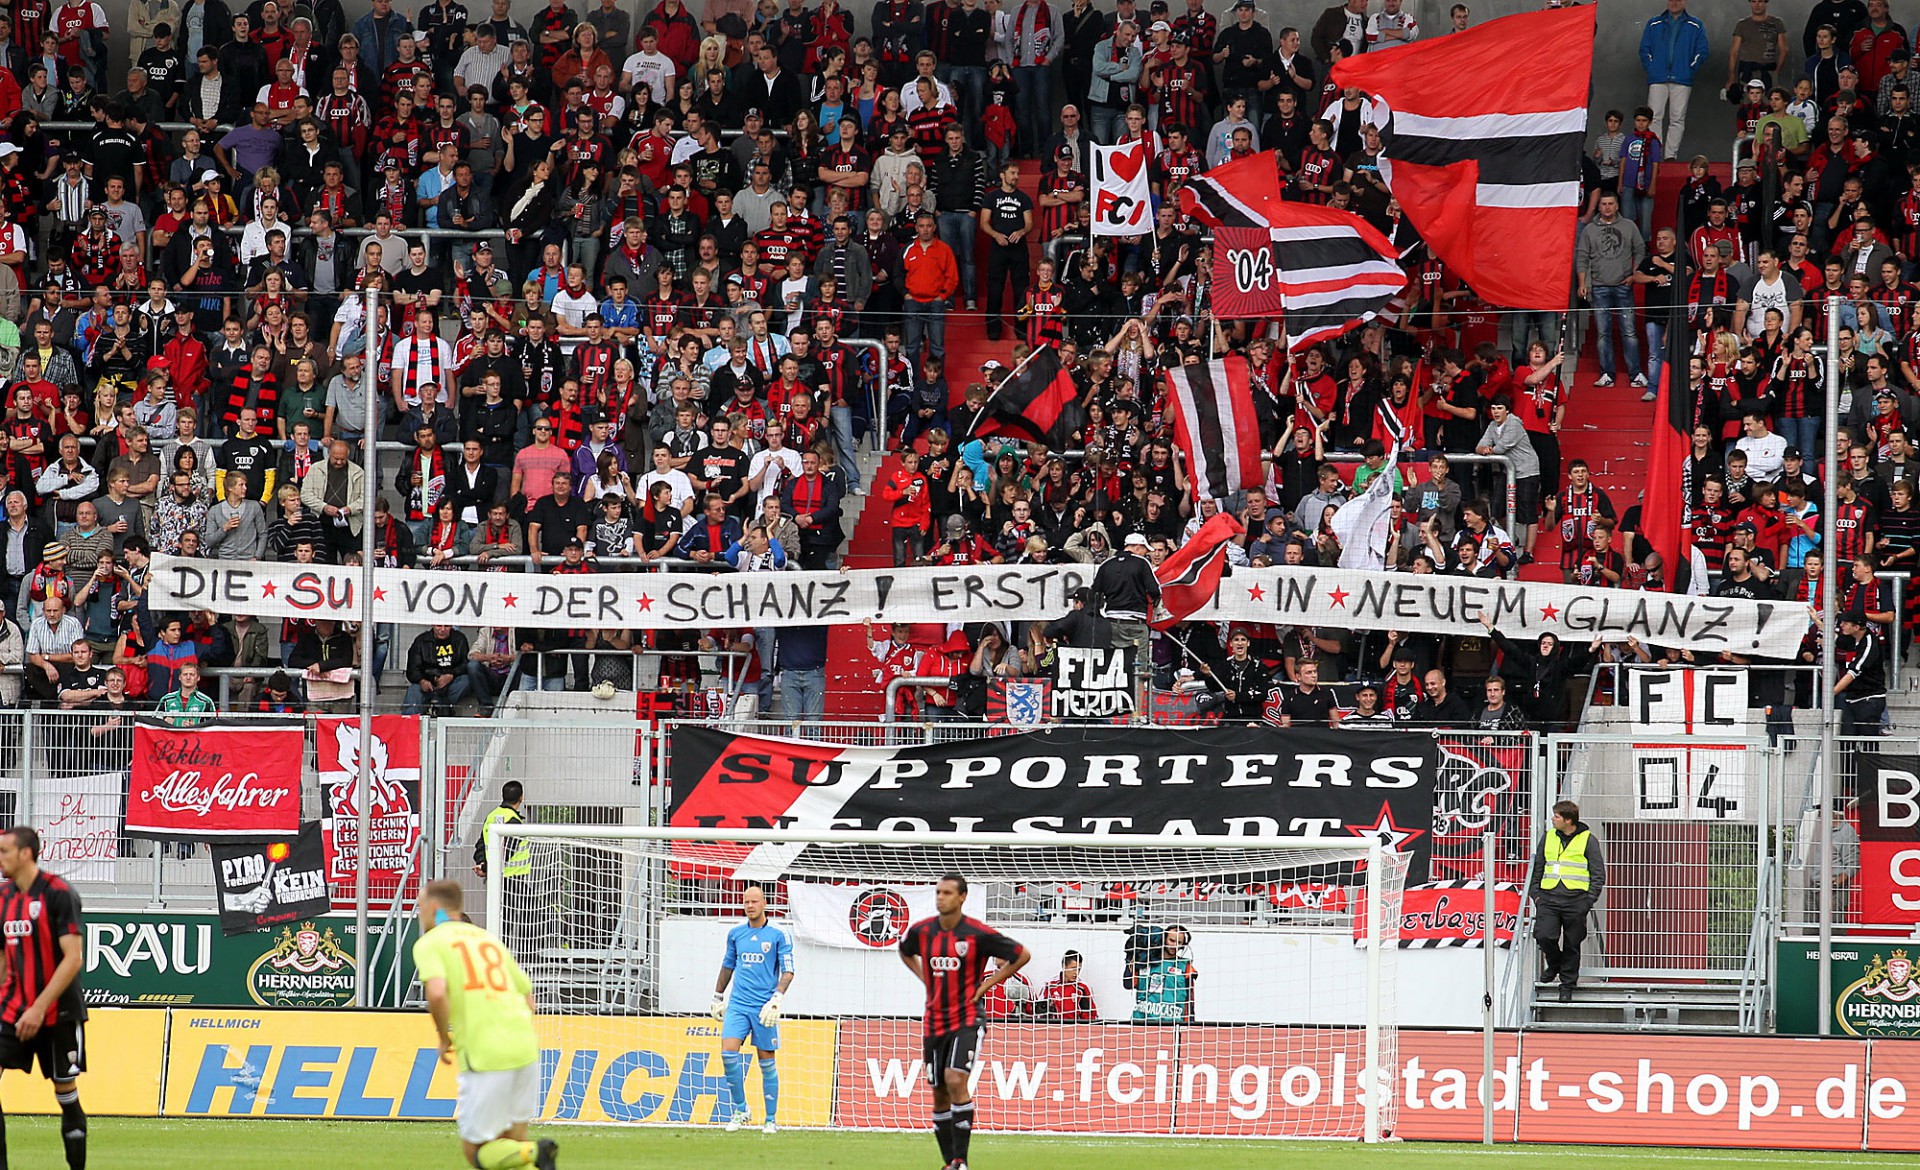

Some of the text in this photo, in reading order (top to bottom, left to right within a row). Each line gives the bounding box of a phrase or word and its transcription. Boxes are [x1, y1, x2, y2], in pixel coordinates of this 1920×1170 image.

[171, 566, 254, 602] DIE
[285, 572, 354, 611] SU
[401, 579, 489, 617] VON
[532, 584, 623, 621] DER
[664, 580, 851, 622] SCHANZ
[1276, 574, 1317, 613] IN
[1353, 579, 1527, 628] NEUEM
[1564, 595, 1735, 642] GLANZ
[717, 752, 1425, 788] SUPPORTERS
[140, 769, 289, 817] Allesfahrer
[221, 853, 266, 881] PYRO
[272, 868, 326, 894] KEIN
[258, 974, 355, 990] HERRNBRÄU
[451, 941, 508, 992] 18
[189, 1018, 261, 1029] HELLMICH
